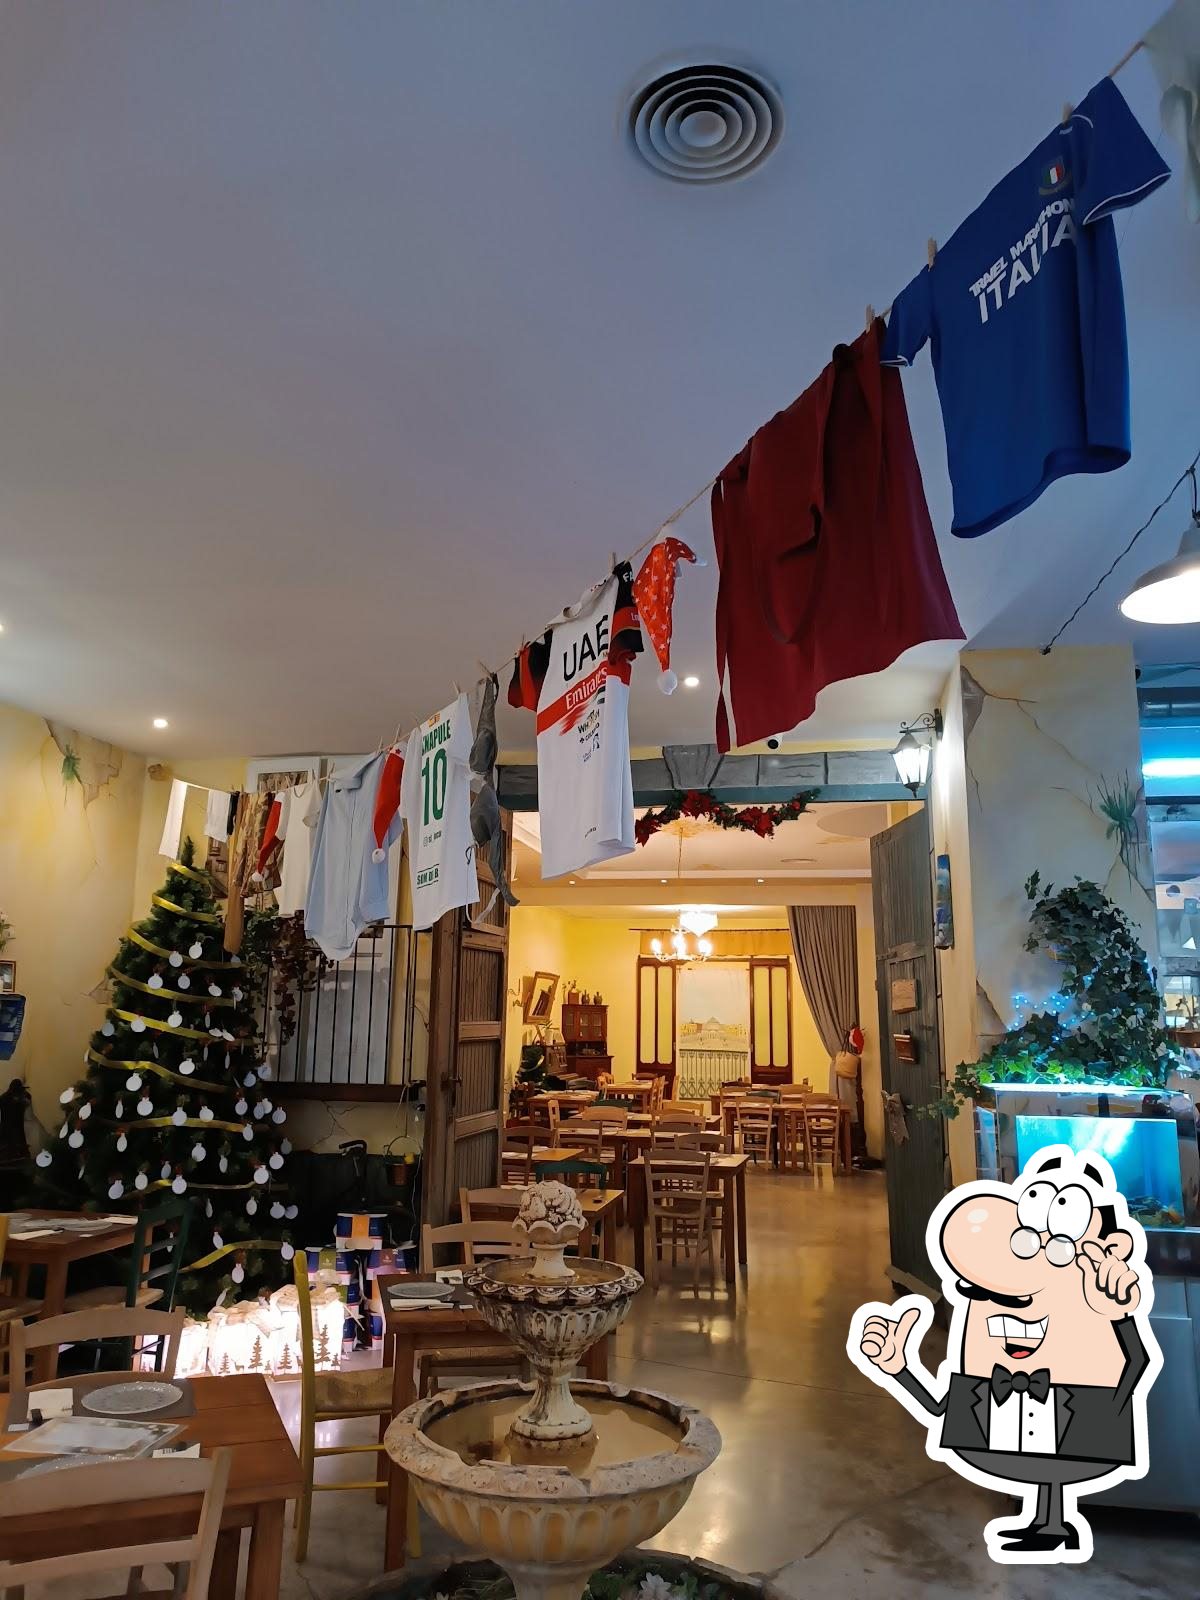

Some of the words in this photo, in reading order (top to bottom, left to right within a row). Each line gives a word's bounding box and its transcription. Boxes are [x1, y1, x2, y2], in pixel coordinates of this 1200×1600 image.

[969, 256, 1008, 297] TRAVEL
[1009, 198, 1075, 260] MARATHON
[978, 214, 1077, 324] ITALIA
[563, 614, 609, 682] UAE
[421, 748, 447, 826] 10
